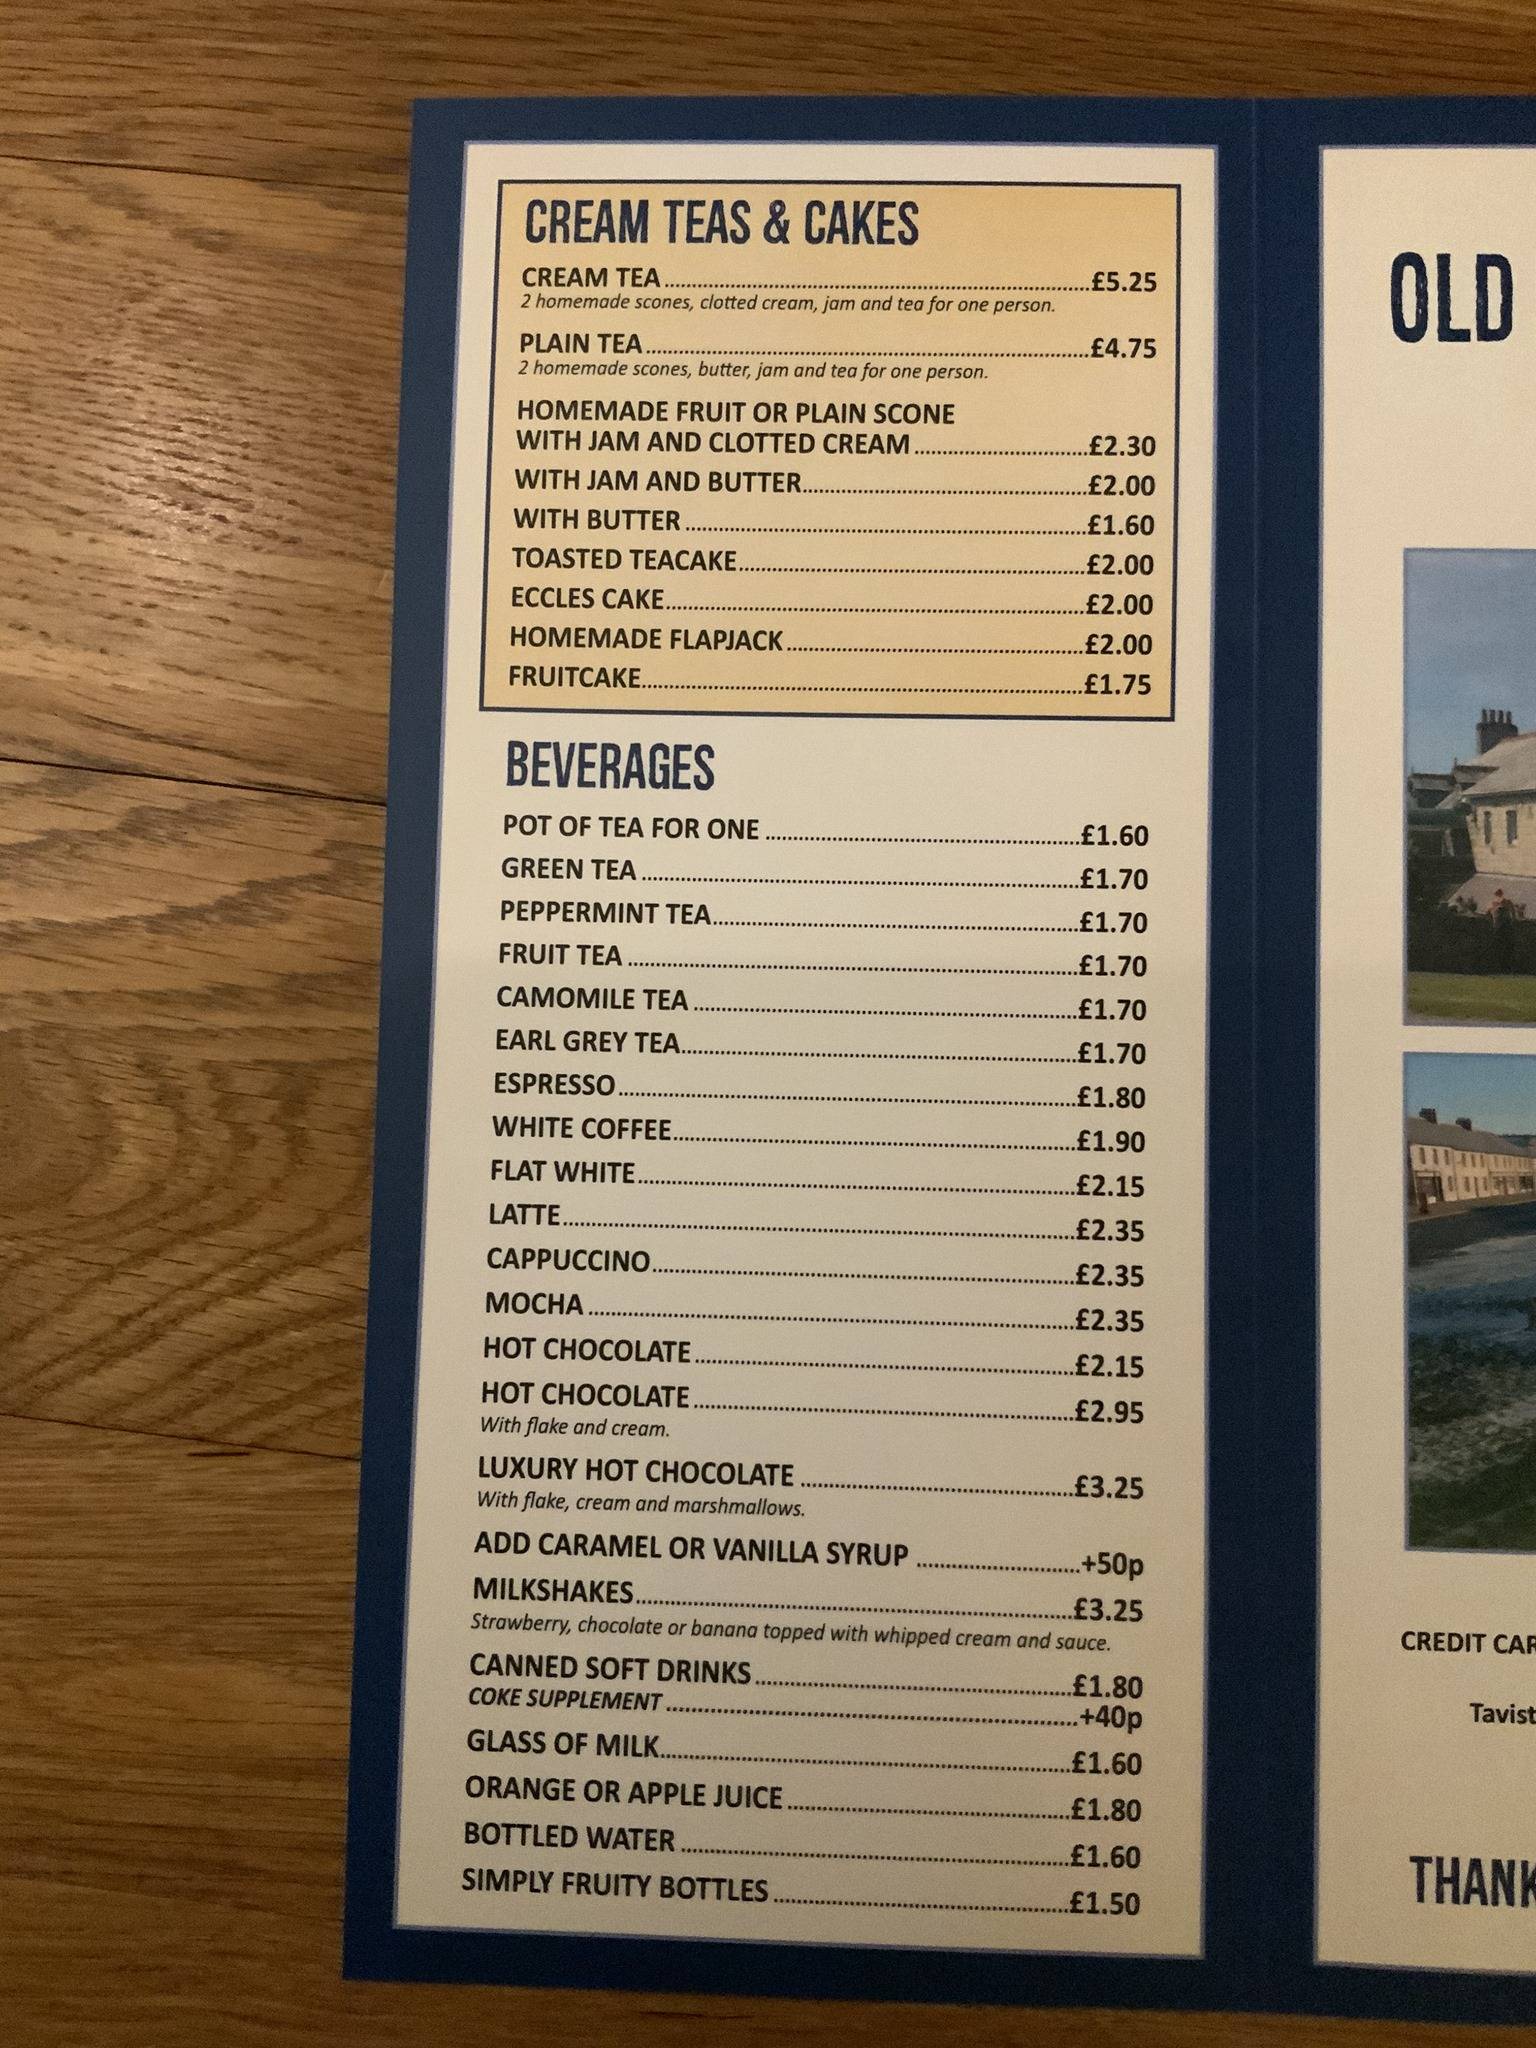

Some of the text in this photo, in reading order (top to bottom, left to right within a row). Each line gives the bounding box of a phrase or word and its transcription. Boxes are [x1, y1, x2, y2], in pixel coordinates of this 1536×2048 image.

[526, 199, 919, 246] CREAM TEAS & CAKES
[522, 267, 1157, 292] CREAM TEA £5.25
[1390, 251, 1514, 343] OLD
[521, 293, 1055, 315] 2 homemade scones, clotted cream, jam and tea for one person.
[520, 333, 1156, 359] PLAIN TEA £4.75
[518, 359, 988, 382] 2 homemade scones, butter, jam and tea for one person.
[518, 400, 955, 424] HOMEMADE FRUIT OR PLAIN SCONE
[516, 430, 1156, 456] WITH JAM AND CLOTTED CREAM £2.30
[515, 469, 1155, 496] WITH JAM AND BUTTER £2.00
[512, 547, 1154, 575] TOASTED TEACAKE £2.00
[512, 587, 1153, 615] ECCLES CAKE £2.00
[511, 626, 1152, 655] HOMEMADE FLAPJACK £2.00
[510, 665, 1151, 695] FRUITCAKE £1.75
[506, 740, 714, 791] BEVERAGES
[504, 814, 1149, 846] POT OF TEA FOR ONE £1.60
[501, 900, 1148, 933] PEPPERMINT TEA £1.70
[499, 943, 1147, 977] FRUIT TEA £1.70
[497, 986, 1146, 1021] CAMOMILE TEA £1.70
[496, 1029, 1146, 1065] EARL GREY TEA £1.70
[495, 1072, 1145, 1109] ESPRESSO £1.80
[492, 1115, 1145, 1153] WHITE COFFEE £1.90
[491, 1159, 1144, 1197] FLAT WHITE £2.15
[490, 1203, 1144, 1242] LATTE £2.35
[487, 1247, 1144, 1287] CAPPUCCINO £2.35
[486, 1292, 1144, 1332] MOCHA £2.35
[482, 1381, 1144, 1424] HOT CHOCOLATE £2.95
[481, 1416, 669, 1437] With flake and cream.
[479, 1456, 1144, 1500] LUXURY HOT CHOCOLATE £3.25
[478, 1491, 804, 1516] With flake, cream and marshmallows.
[474, 1531, 1144, 1581] ADD CARAMEL OR VANILLA SYRUP +50p
[474, 1577, 1143, 1622] MILKSHAKES £3.25
[471, 1613, 1110, 1651] Strawberry, chocolate or banana topped with whipped cream and sauce.
[1401, 1630, 1487, 1653] CREDIT
[470, 1653, 1143, 1699] CANNED SOFT DRINKS £1.80
[468, 1687, 1142, 1734] COKE SUPPLEMENT +40p
[465, 1775, 1141, 1822] ORANGE OR APPLE JUICE £1.80
[465, 1822, 1141, 1869] BOTTLED WATER £1.60
[462, 1868, 1141, 1916] SIMPLY FRUITY BOTTLES £1.50
